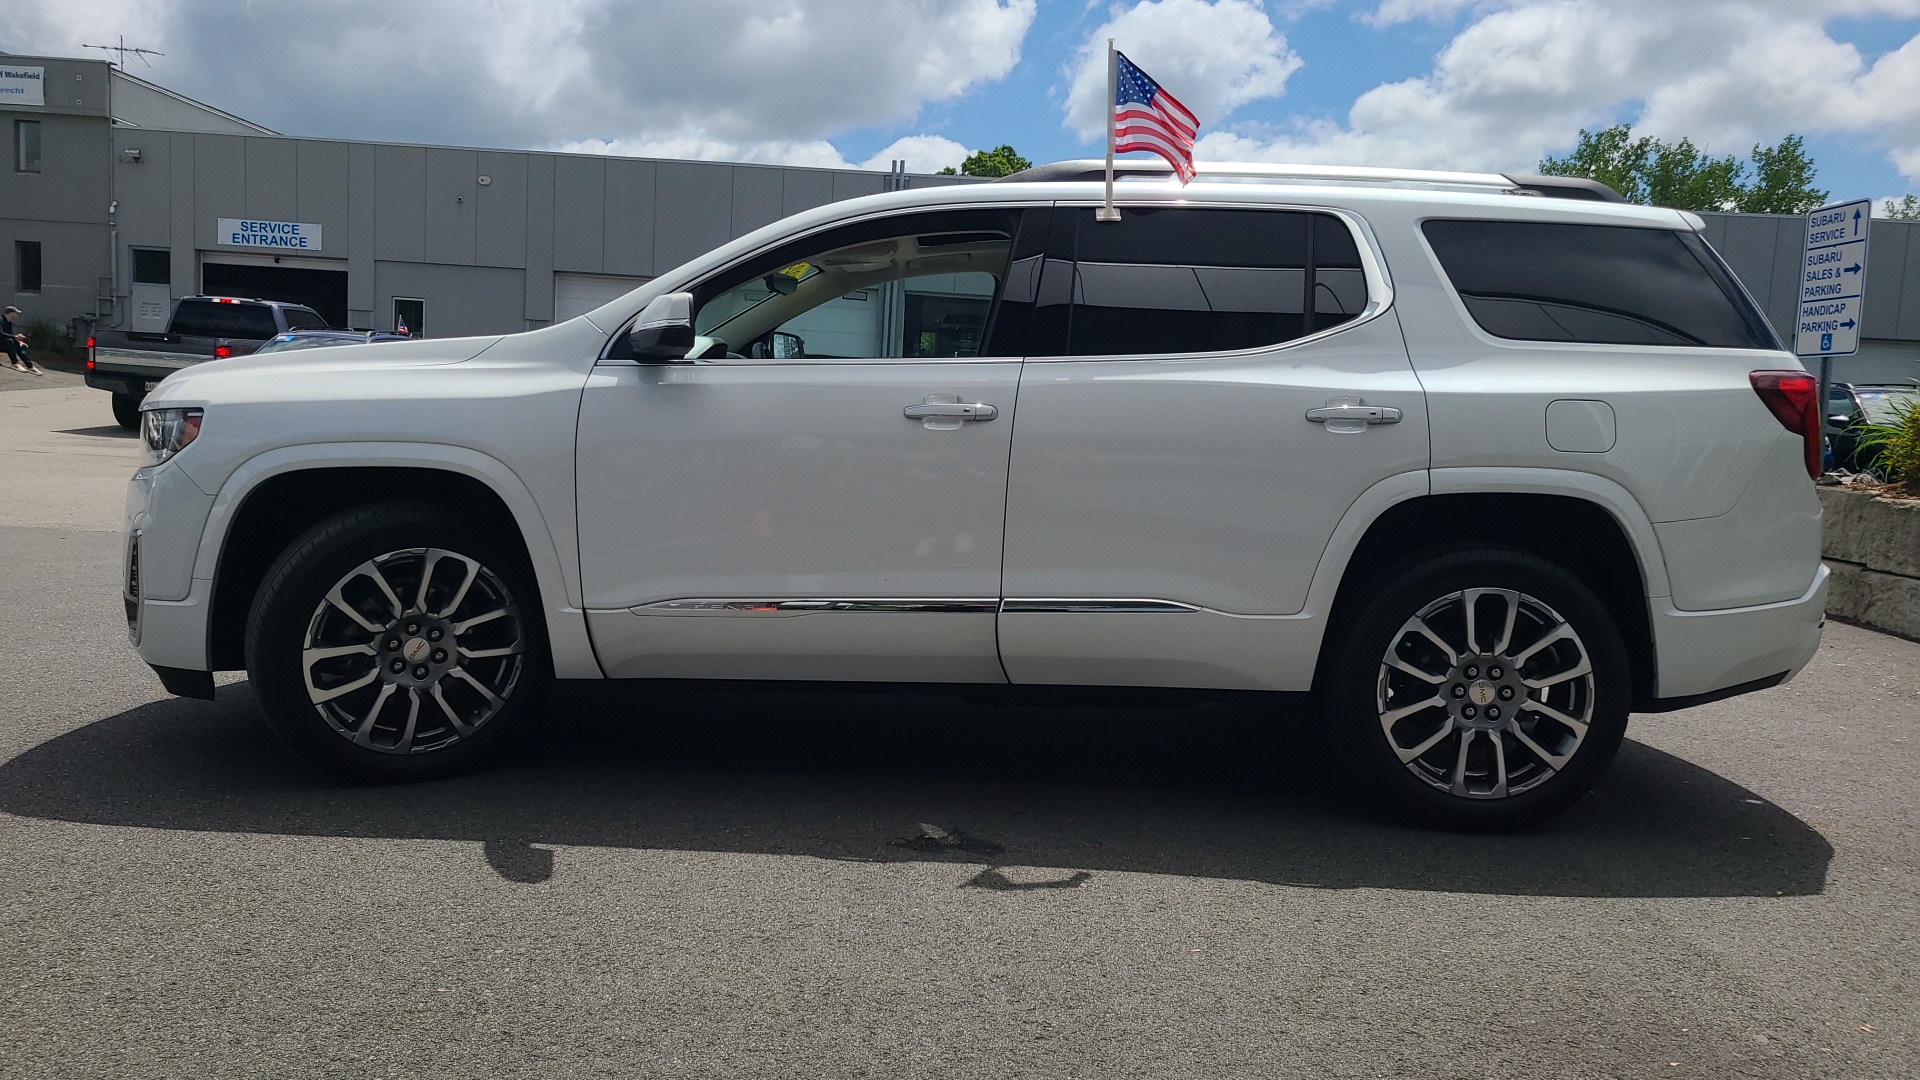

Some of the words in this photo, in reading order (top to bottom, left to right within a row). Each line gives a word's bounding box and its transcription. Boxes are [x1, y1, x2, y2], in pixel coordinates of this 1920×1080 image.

[5, 71, 40, 80] Wakefield
[1810, 211, 1846, 228] SUBARU
[240, 221, 300, 235] SERVICE
[1809, 227, 1845, 244] SERVICE
[232, 233, 307, 247] ENTRANCE
[1807, 251, 1842, 266] SUBARU
[1806, 268, 1833, 282] SALES
[1834, 267, 1841, 278] &
[1804, 283, 1842, 298] PARKING
[1802, 303, 1846, 317] HANDICAP
[1801, 320, 1838, 333] PARKING
[408, 640, 426, 660] GMC
[1478, 682, 1486, 703] GMC
